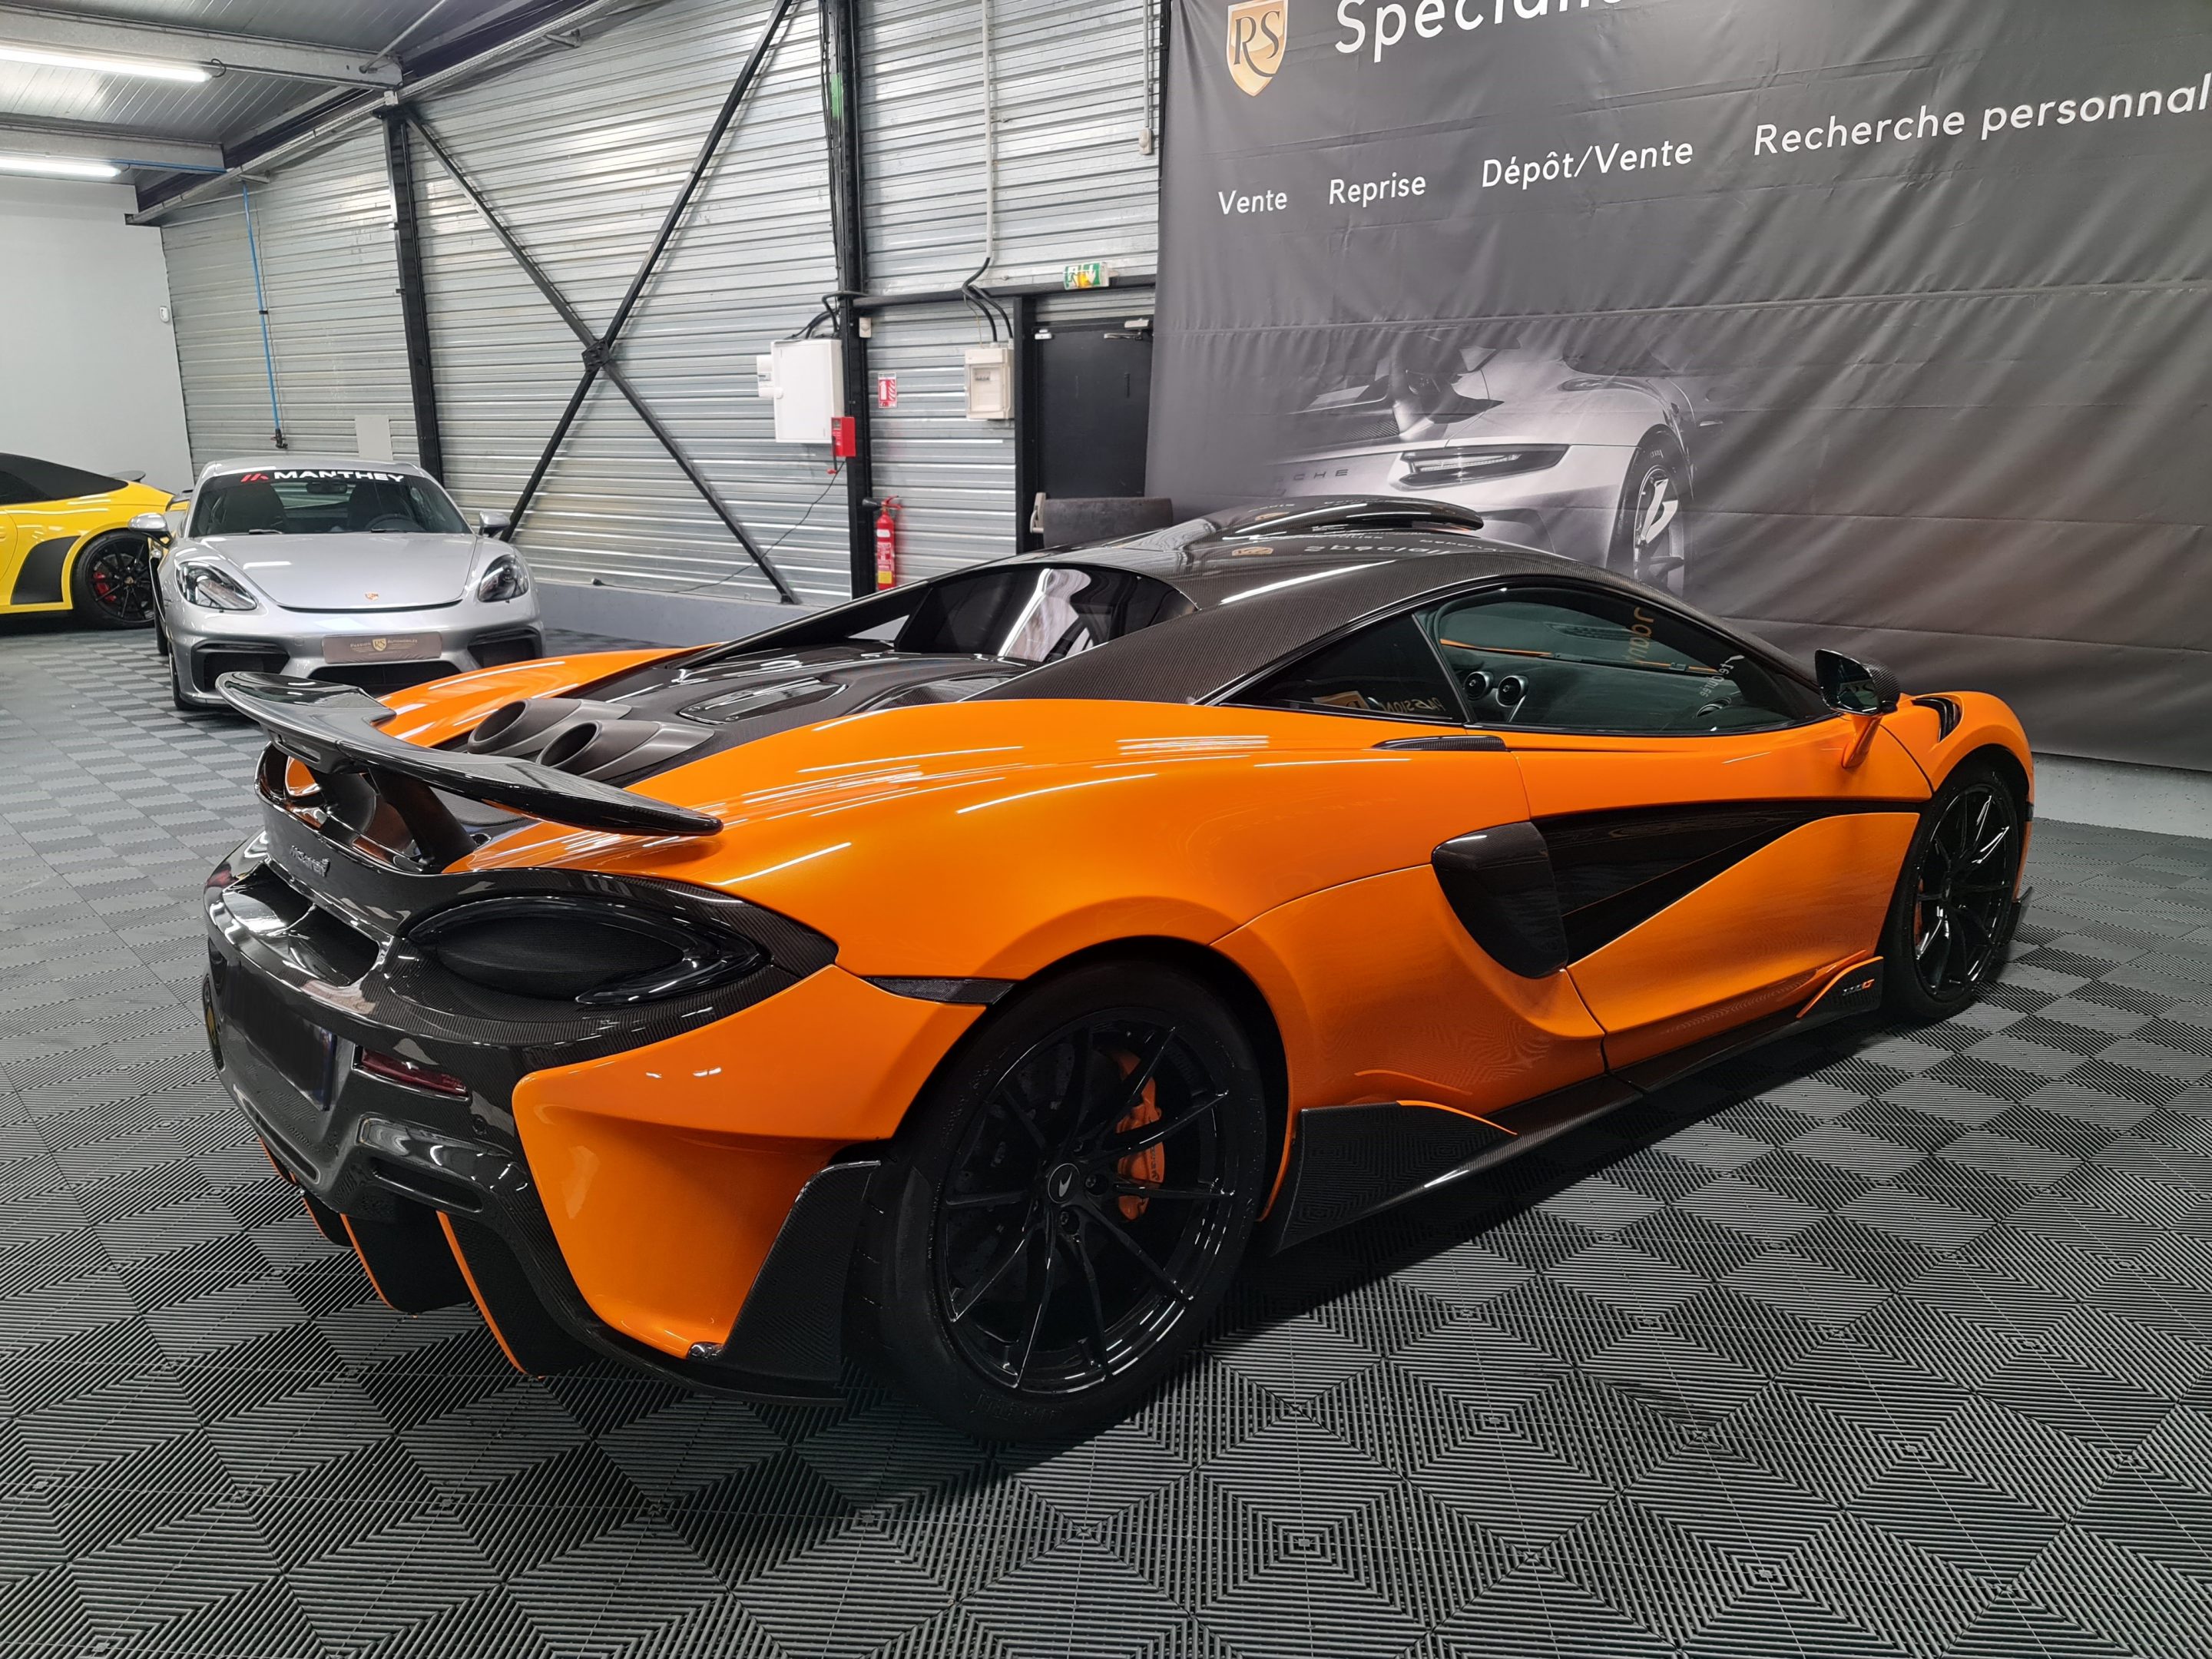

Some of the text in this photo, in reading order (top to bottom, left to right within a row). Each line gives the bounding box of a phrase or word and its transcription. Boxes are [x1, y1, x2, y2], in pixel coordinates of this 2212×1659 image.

[1233, 10, 1280, 78] RS
[1218, 72, 2212, 215] Vente Reprise Dépôt/Vente Recherche personnal
[274, 471, 404, 482] MANTHEY
